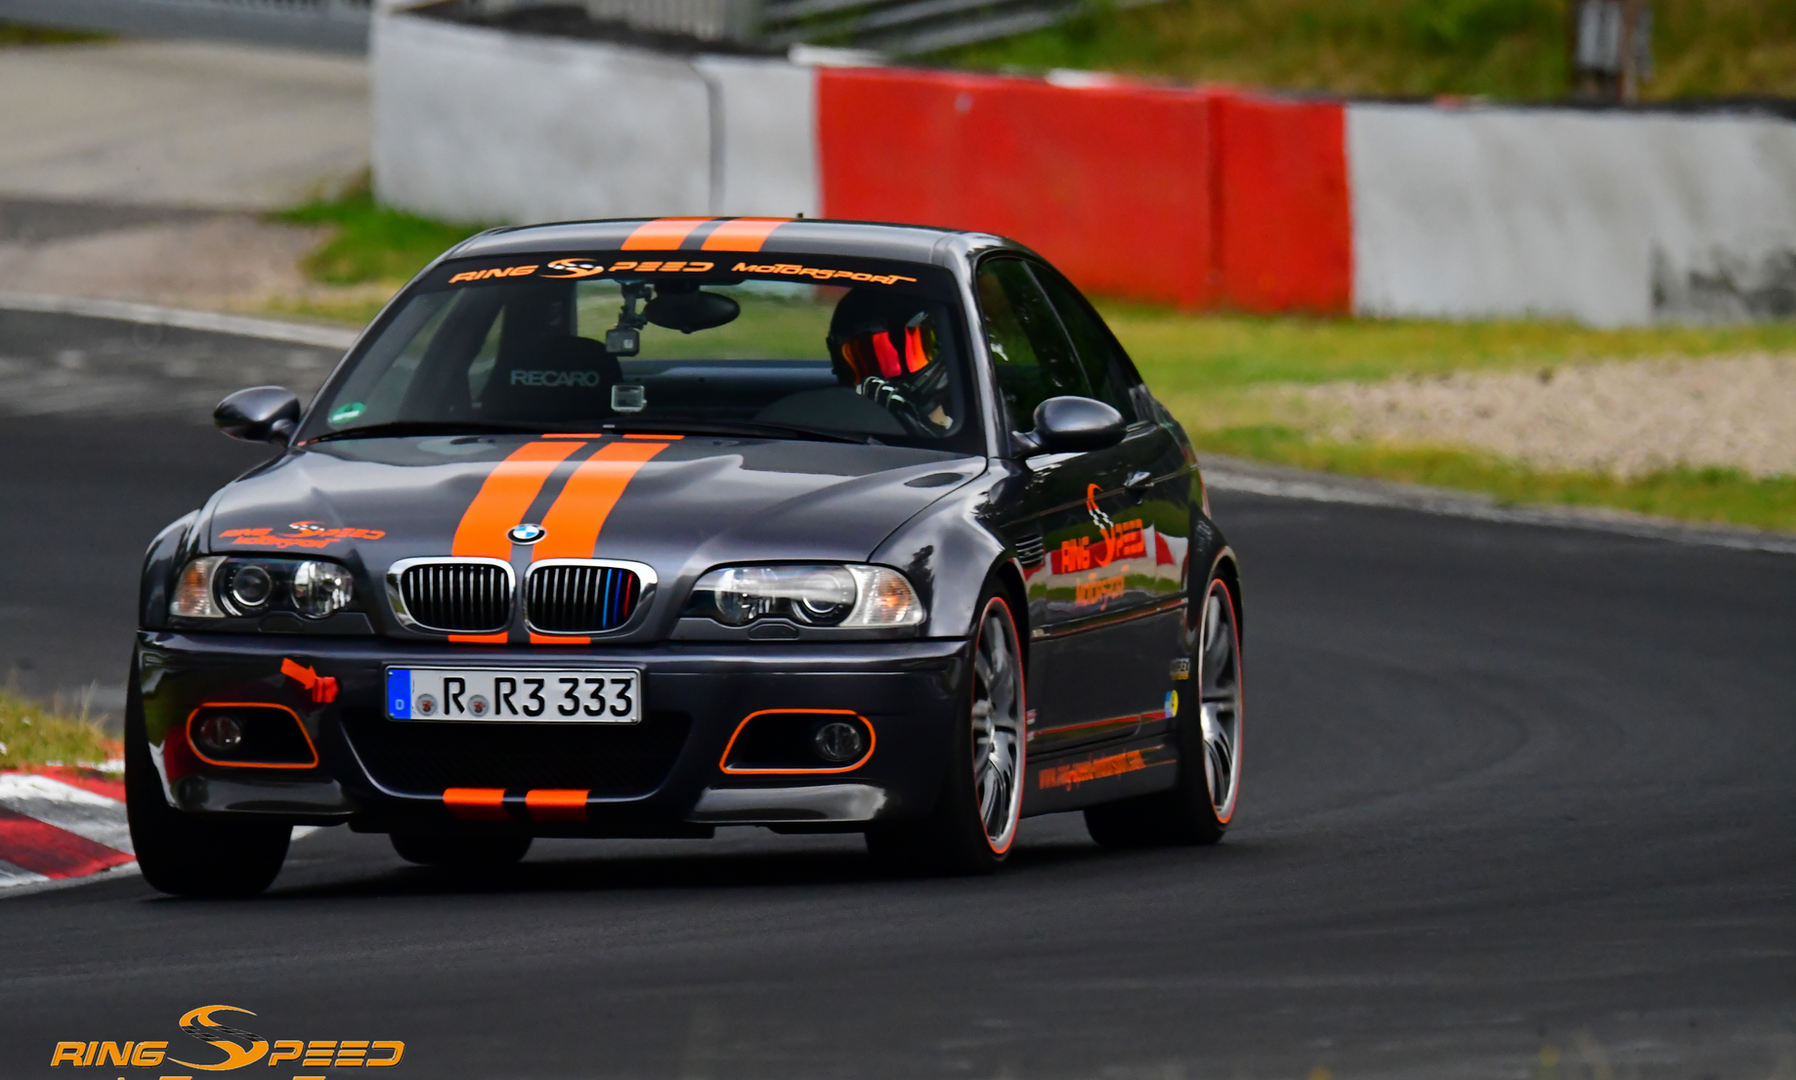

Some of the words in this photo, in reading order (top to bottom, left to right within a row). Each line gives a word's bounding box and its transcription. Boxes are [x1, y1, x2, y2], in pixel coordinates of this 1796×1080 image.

[448, 265, 539, 284] RING
[510, 370, 600, 387] RECARO
[443, 677, 465, 715] R
